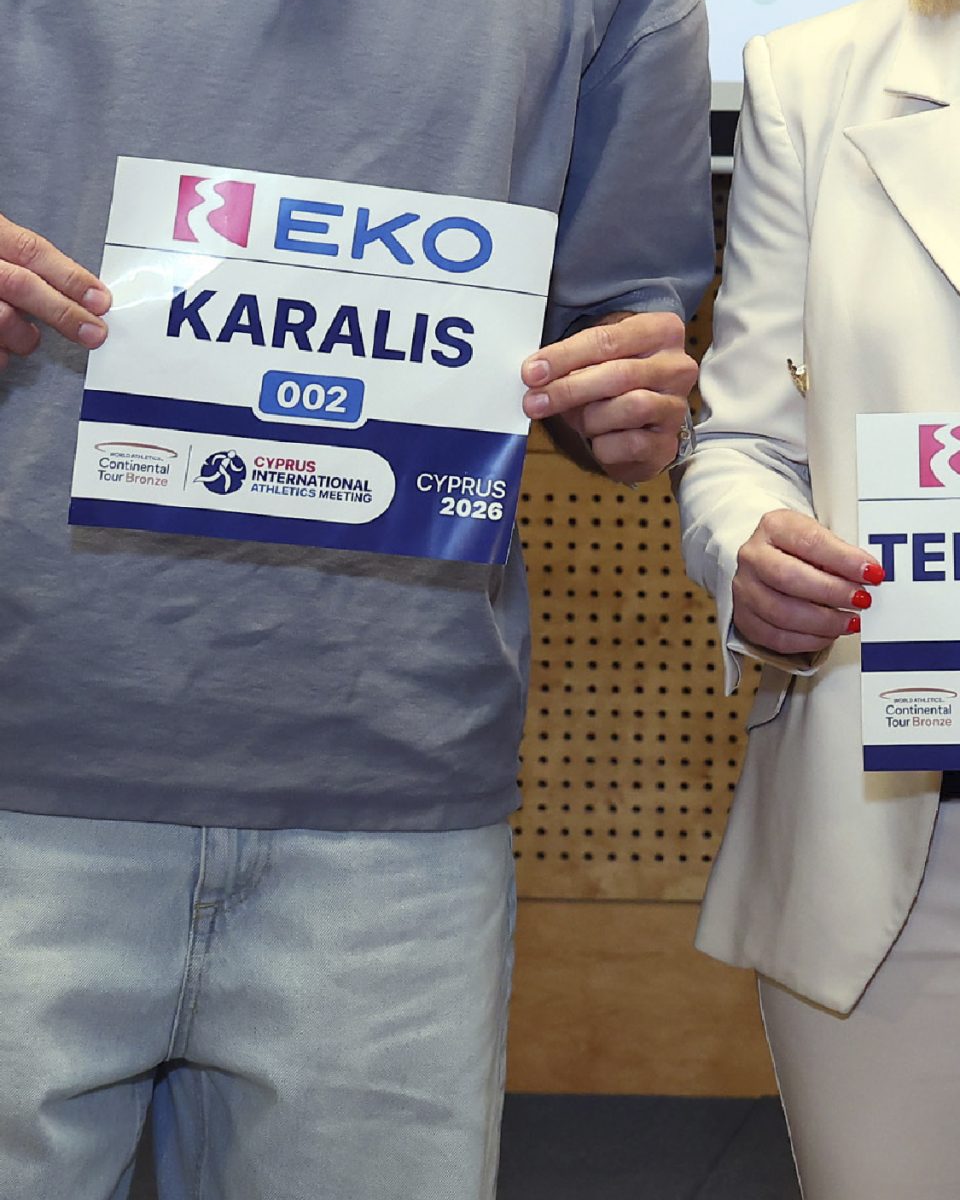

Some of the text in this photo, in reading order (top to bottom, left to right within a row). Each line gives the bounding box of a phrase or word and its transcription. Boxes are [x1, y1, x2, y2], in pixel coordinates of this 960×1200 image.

[273, 196, 493, 274] EKO
[166, 287, 475, 369] KARALIS
[276, 380, 347, 414] 002
[98, 456, 170, 475] Continental
[253, 456, 316, 473] CYPRUS
[97, 469, 169, 487] Tour Bronze
[251, 469, 373, 492] INTERNATIONAL
[416, 473, 507, 499] CYPRUS
[250, 483, 373, 504] ATHLETICS MEETING
[439, 496, 503, 521] 2026
[885, 703, 952, 715] Continental
[885, 716, 953, 728] Tour Bronze
